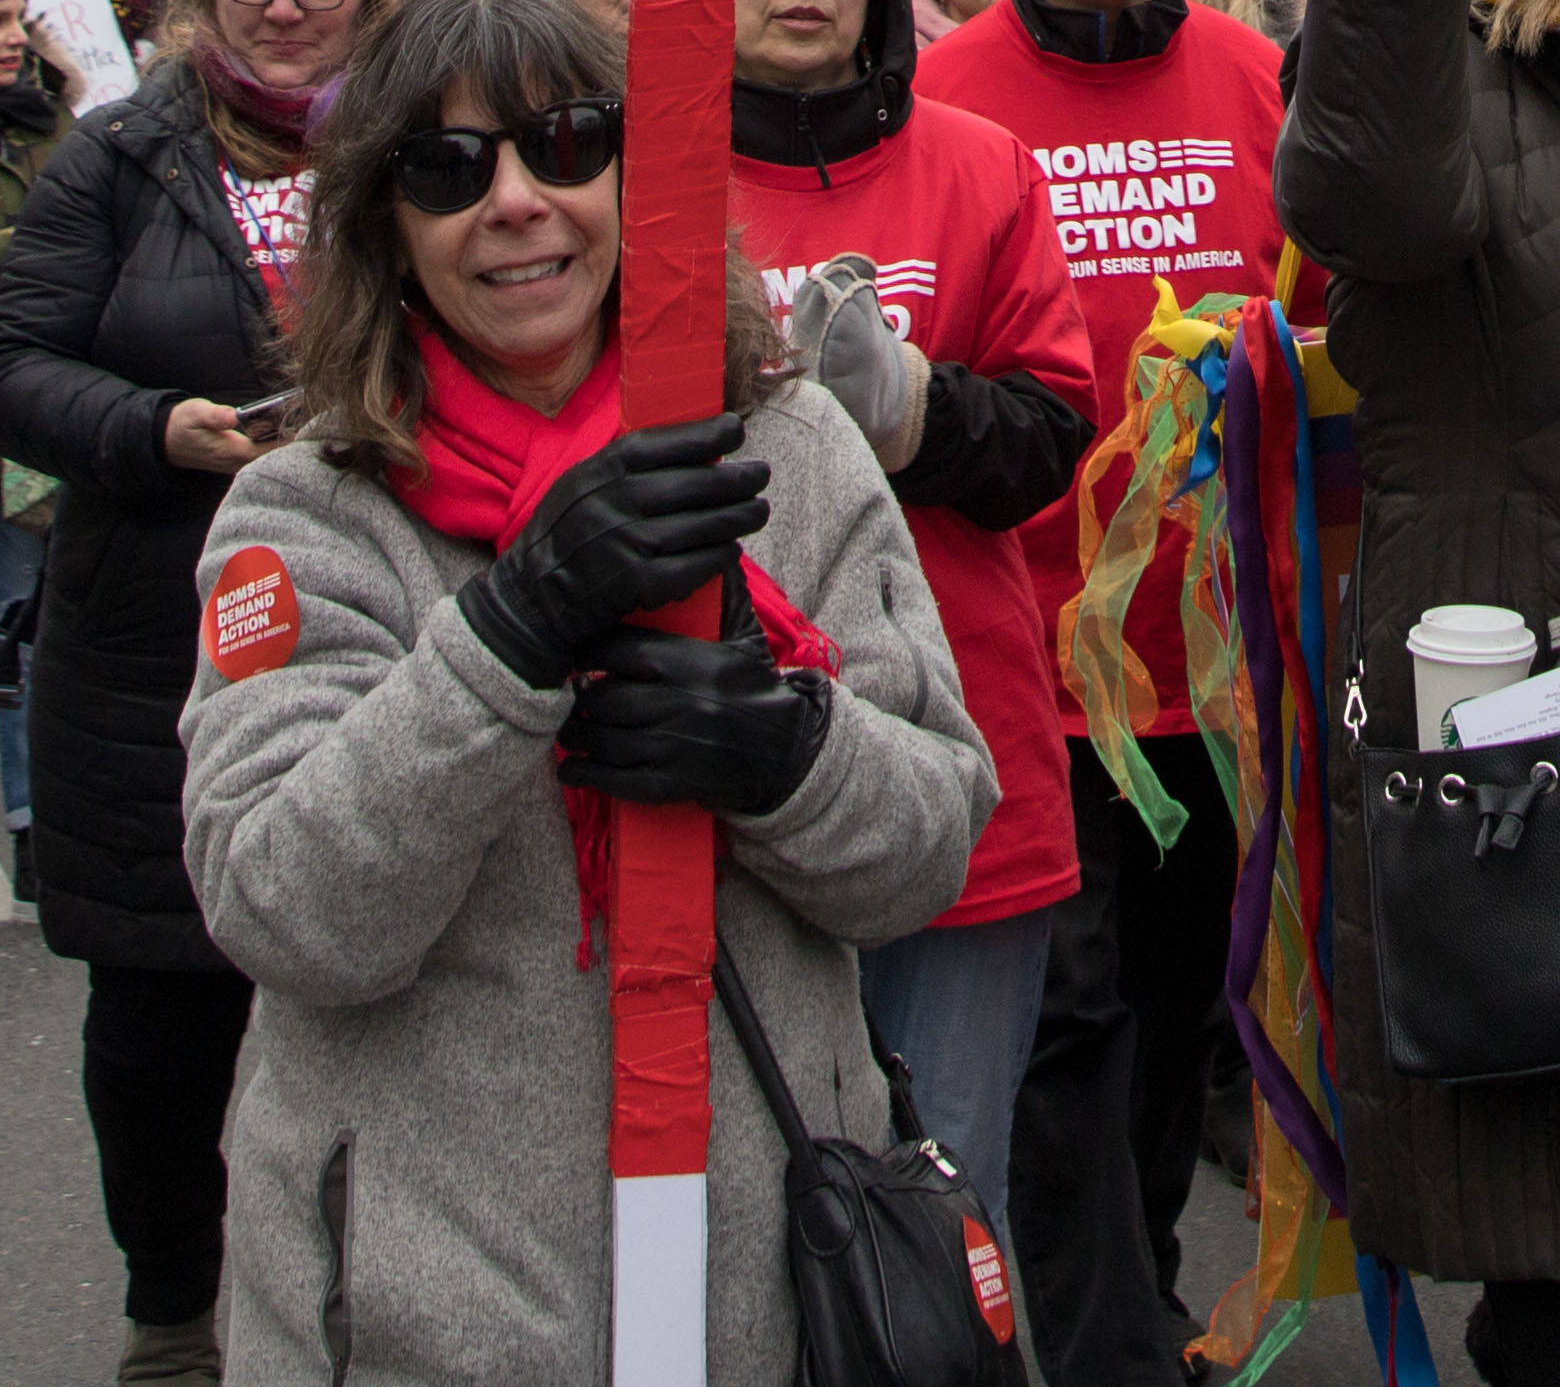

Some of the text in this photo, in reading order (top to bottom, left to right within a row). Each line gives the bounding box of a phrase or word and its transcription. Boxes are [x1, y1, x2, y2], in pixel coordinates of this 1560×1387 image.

[1049, 173, 1216, 216] EMAND
[1056, 212, 1197, 254] CTION
[1101, 257, 1150, 274] SENSE
[1154, 256, 1170, 273] IN
[1174, 250, 1244, 271] AMERICA
[217, 581, 256, 612] MOMS
[218, 592, 275, 629] DEMAND
[218, 611, 270, 645] ACTION
